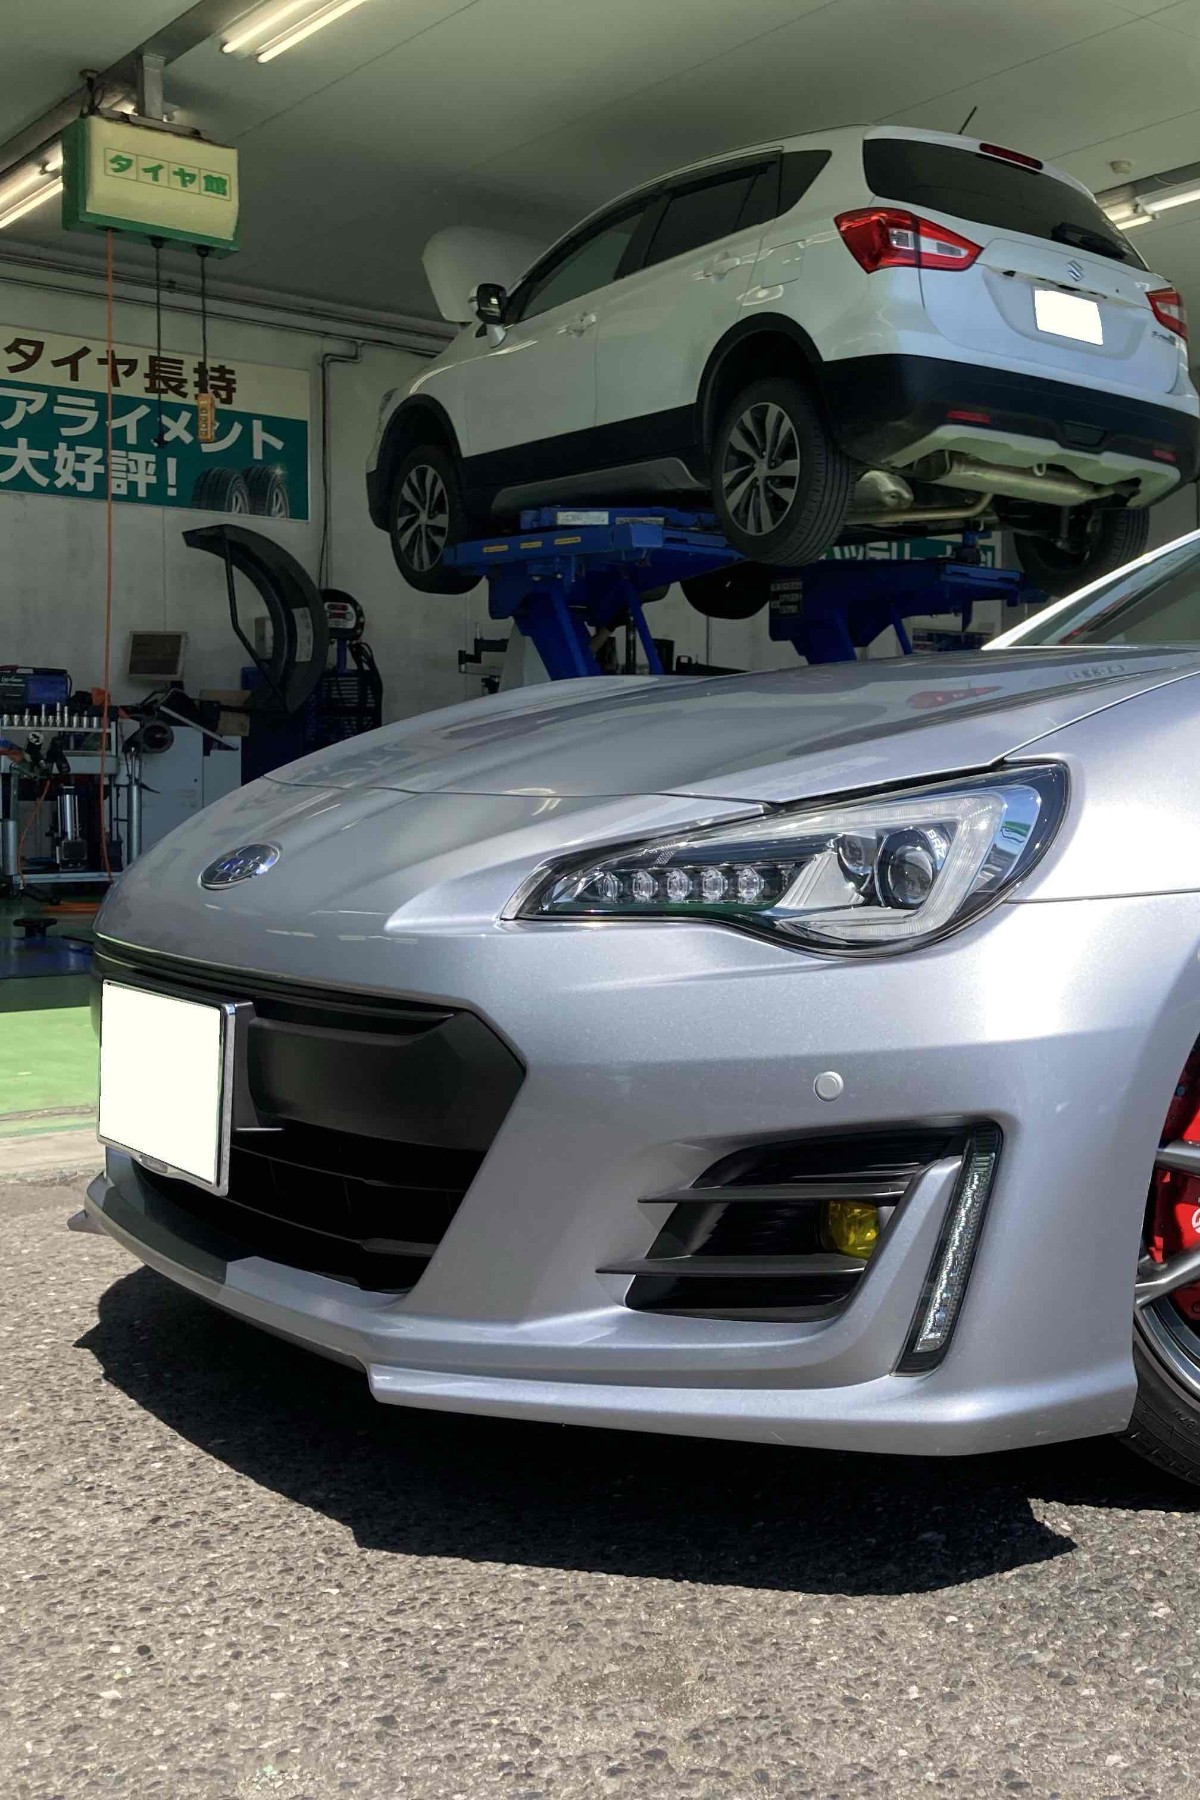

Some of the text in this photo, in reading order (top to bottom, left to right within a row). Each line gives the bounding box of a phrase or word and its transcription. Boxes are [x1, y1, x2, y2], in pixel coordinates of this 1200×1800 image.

[109, 154, 228, 197] タイヤ館
[3, 337, 237, 406] タイヤ長持
[0, 386, 285, 461] アライメント
[0, 437, 178, 498] 大好評!
[926, 829, 946, 860] BRZ
